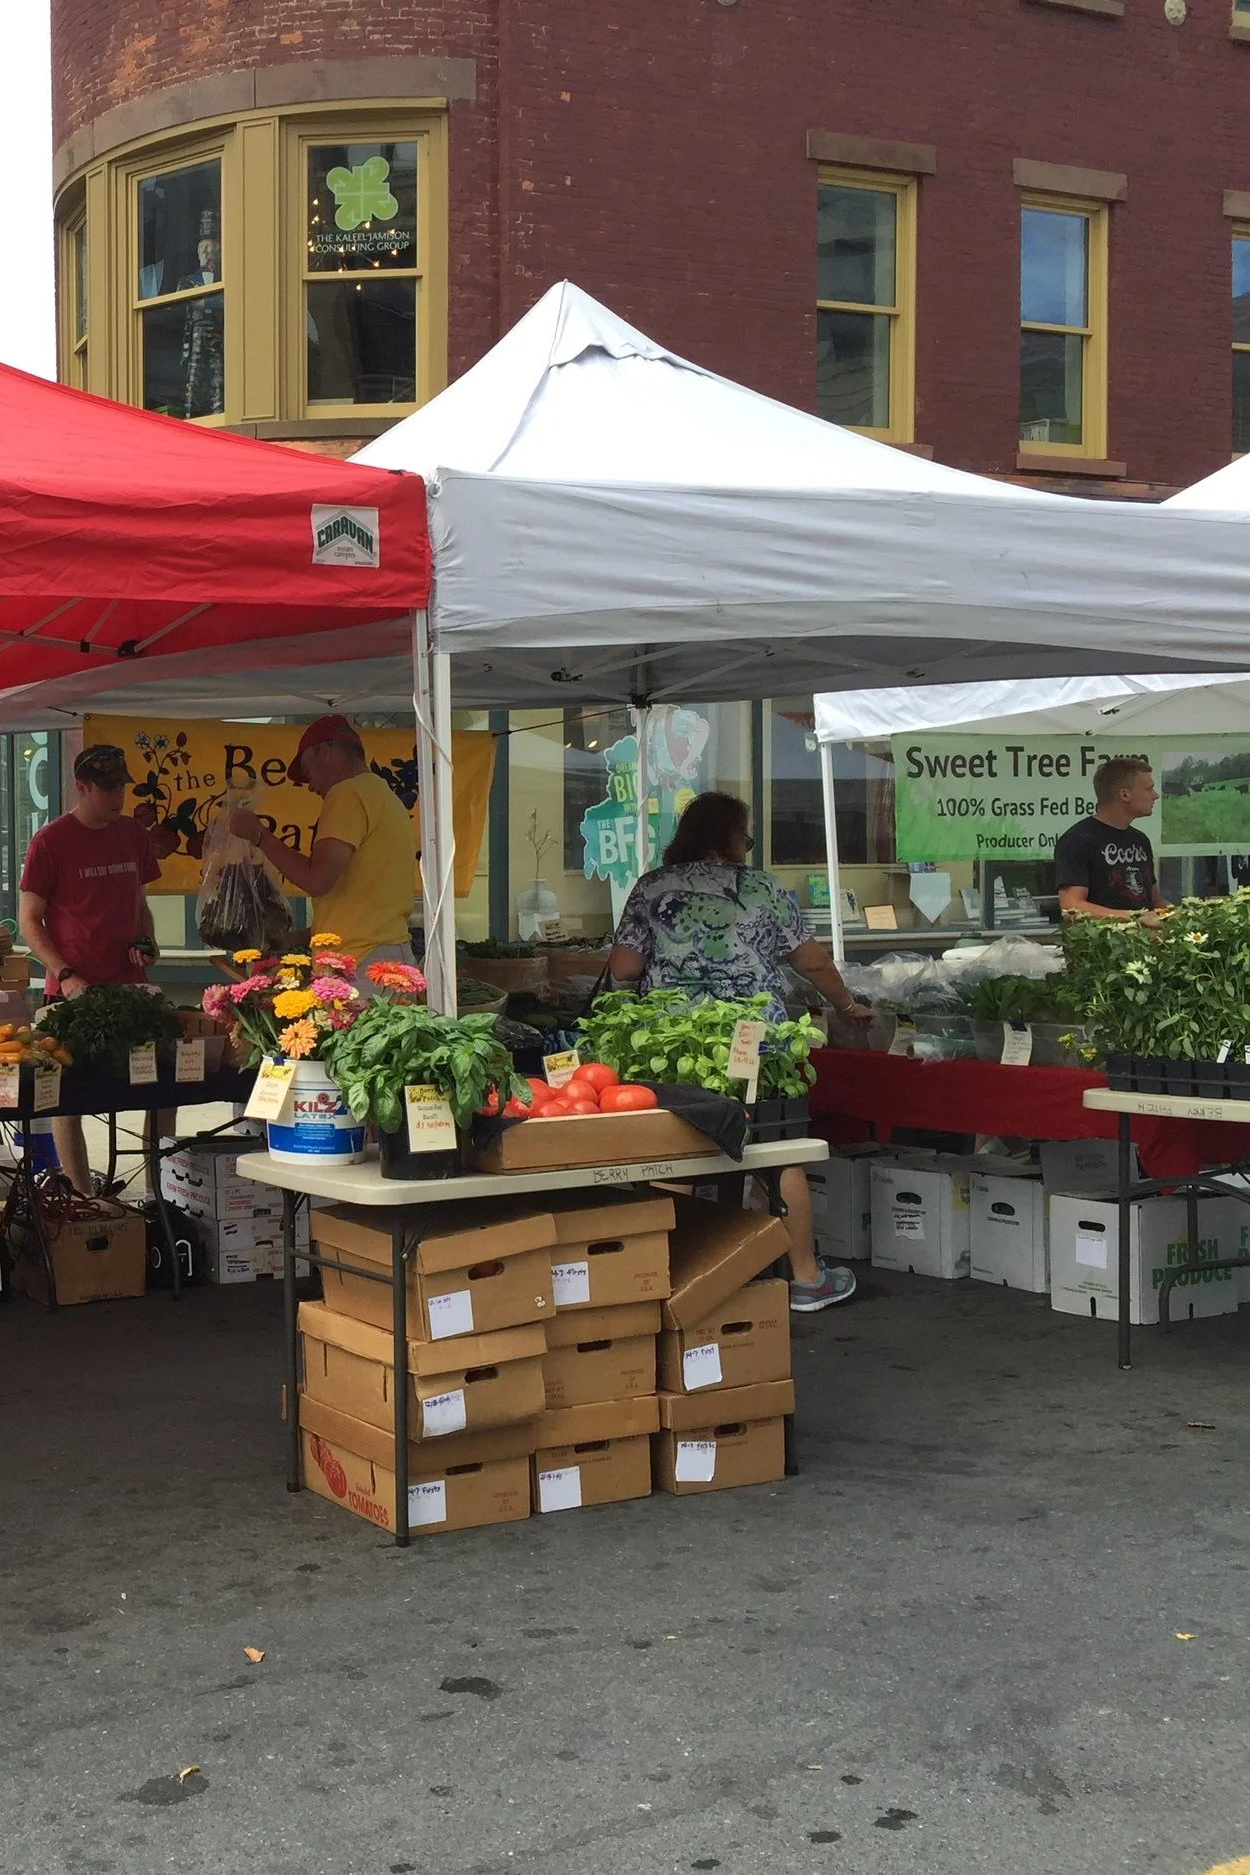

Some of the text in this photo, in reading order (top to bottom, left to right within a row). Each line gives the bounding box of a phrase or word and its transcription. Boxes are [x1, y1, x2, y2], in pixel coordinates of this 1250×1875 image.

[315, 231, 410, 243] THE KALEEL JAMISON
[315, 241, 410, 253] CONSULTING GROUP
[317, 516, 374, 554] CARAVAN
[174, 744, 303, 791] the Be
[906, 746, 998, 779] Sweet
[1005, 746, 1071, 778] Tree
[937, 798, 986, 818] 100%
[991, 798, 1035, 818] Grass
[1040, 798, 1069, 818] Fed
[977, 833, 1034, 848] Producer
[1101, 842, 1148, 866] Coors
[293, 1100, 337, 1113] KILZ
[593, 1163, 674, 1184] BERRY PATCH
[1167, 1238, 1218, 1265] FRSH
[348, 1490, 390, 1526] TOMATOES
